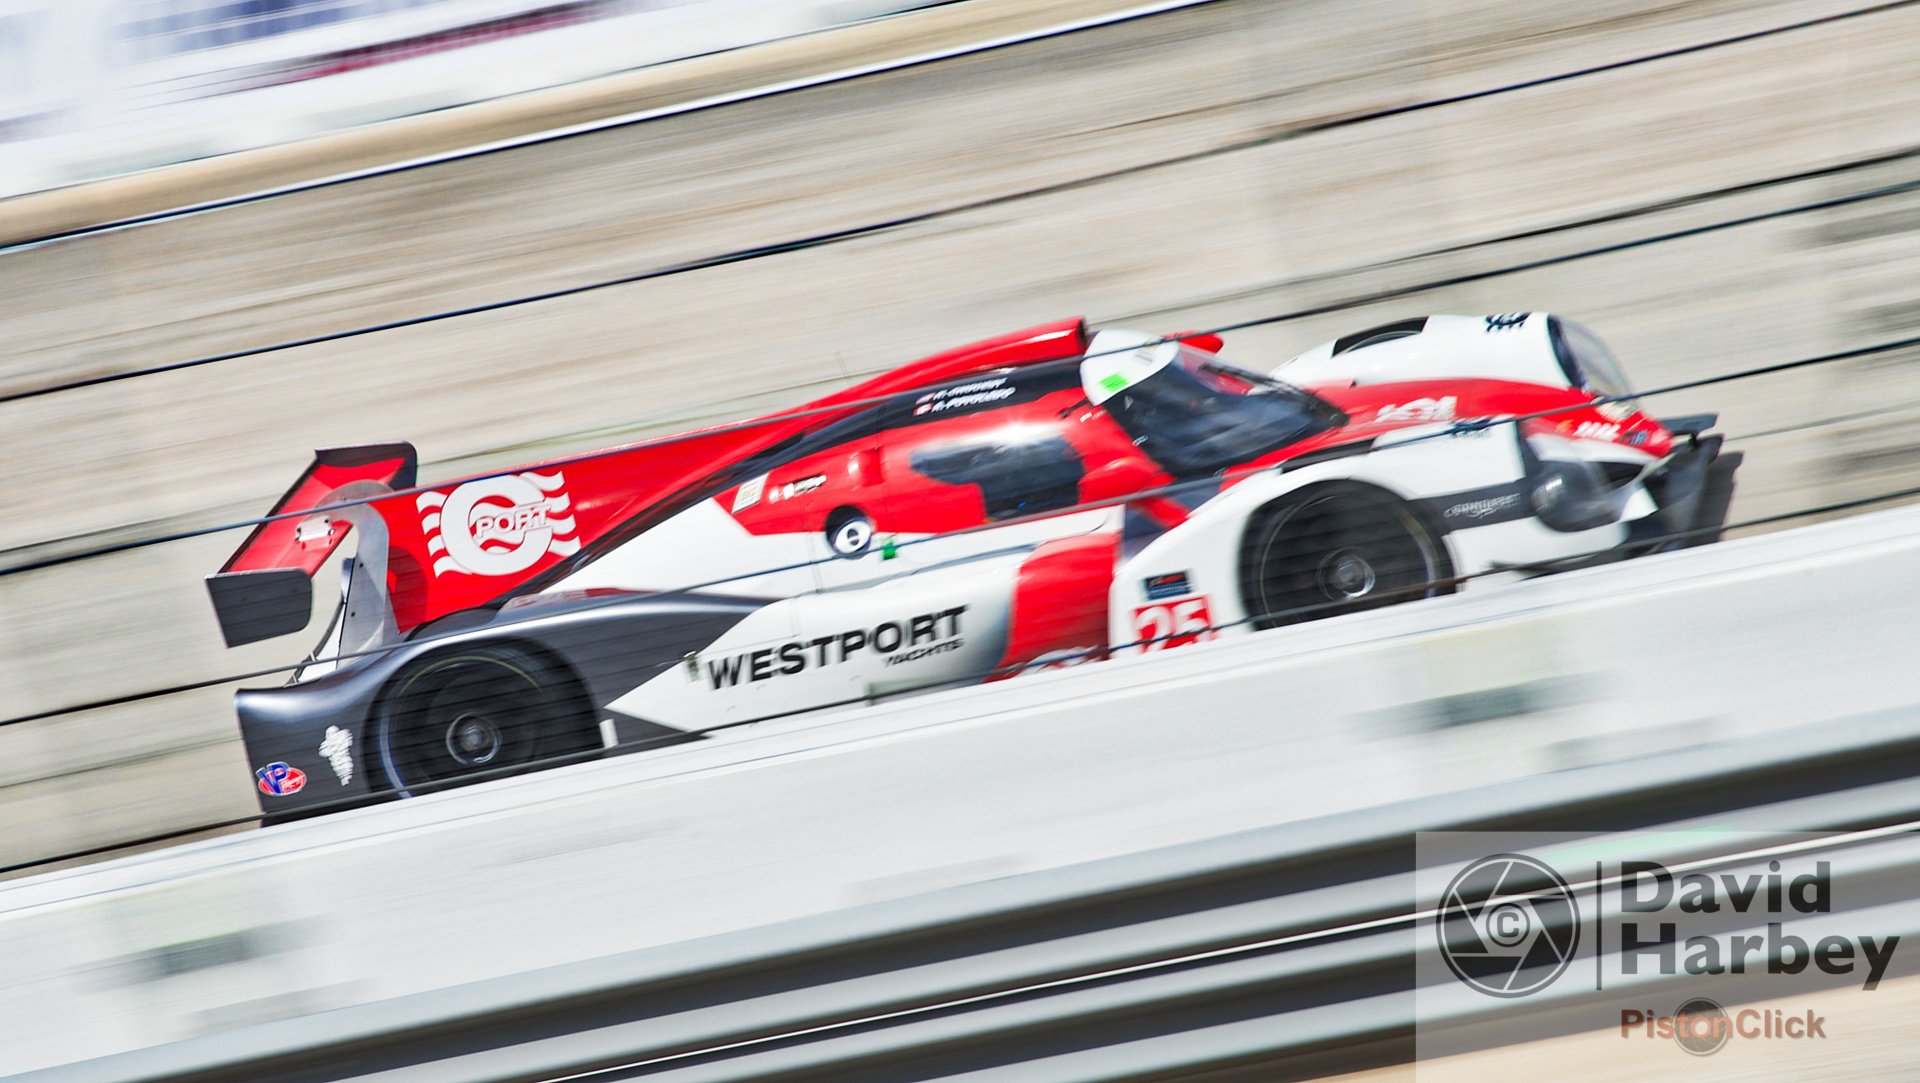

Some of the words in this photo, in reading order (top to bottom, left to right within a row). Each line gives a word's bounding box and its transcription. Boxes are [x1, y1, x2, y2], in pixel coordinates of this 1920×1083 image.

[475, 503, 551, 538] PORT
[707, 604, 971, 690] WESTPORT
[1134, 600, 1210, 652] 25
